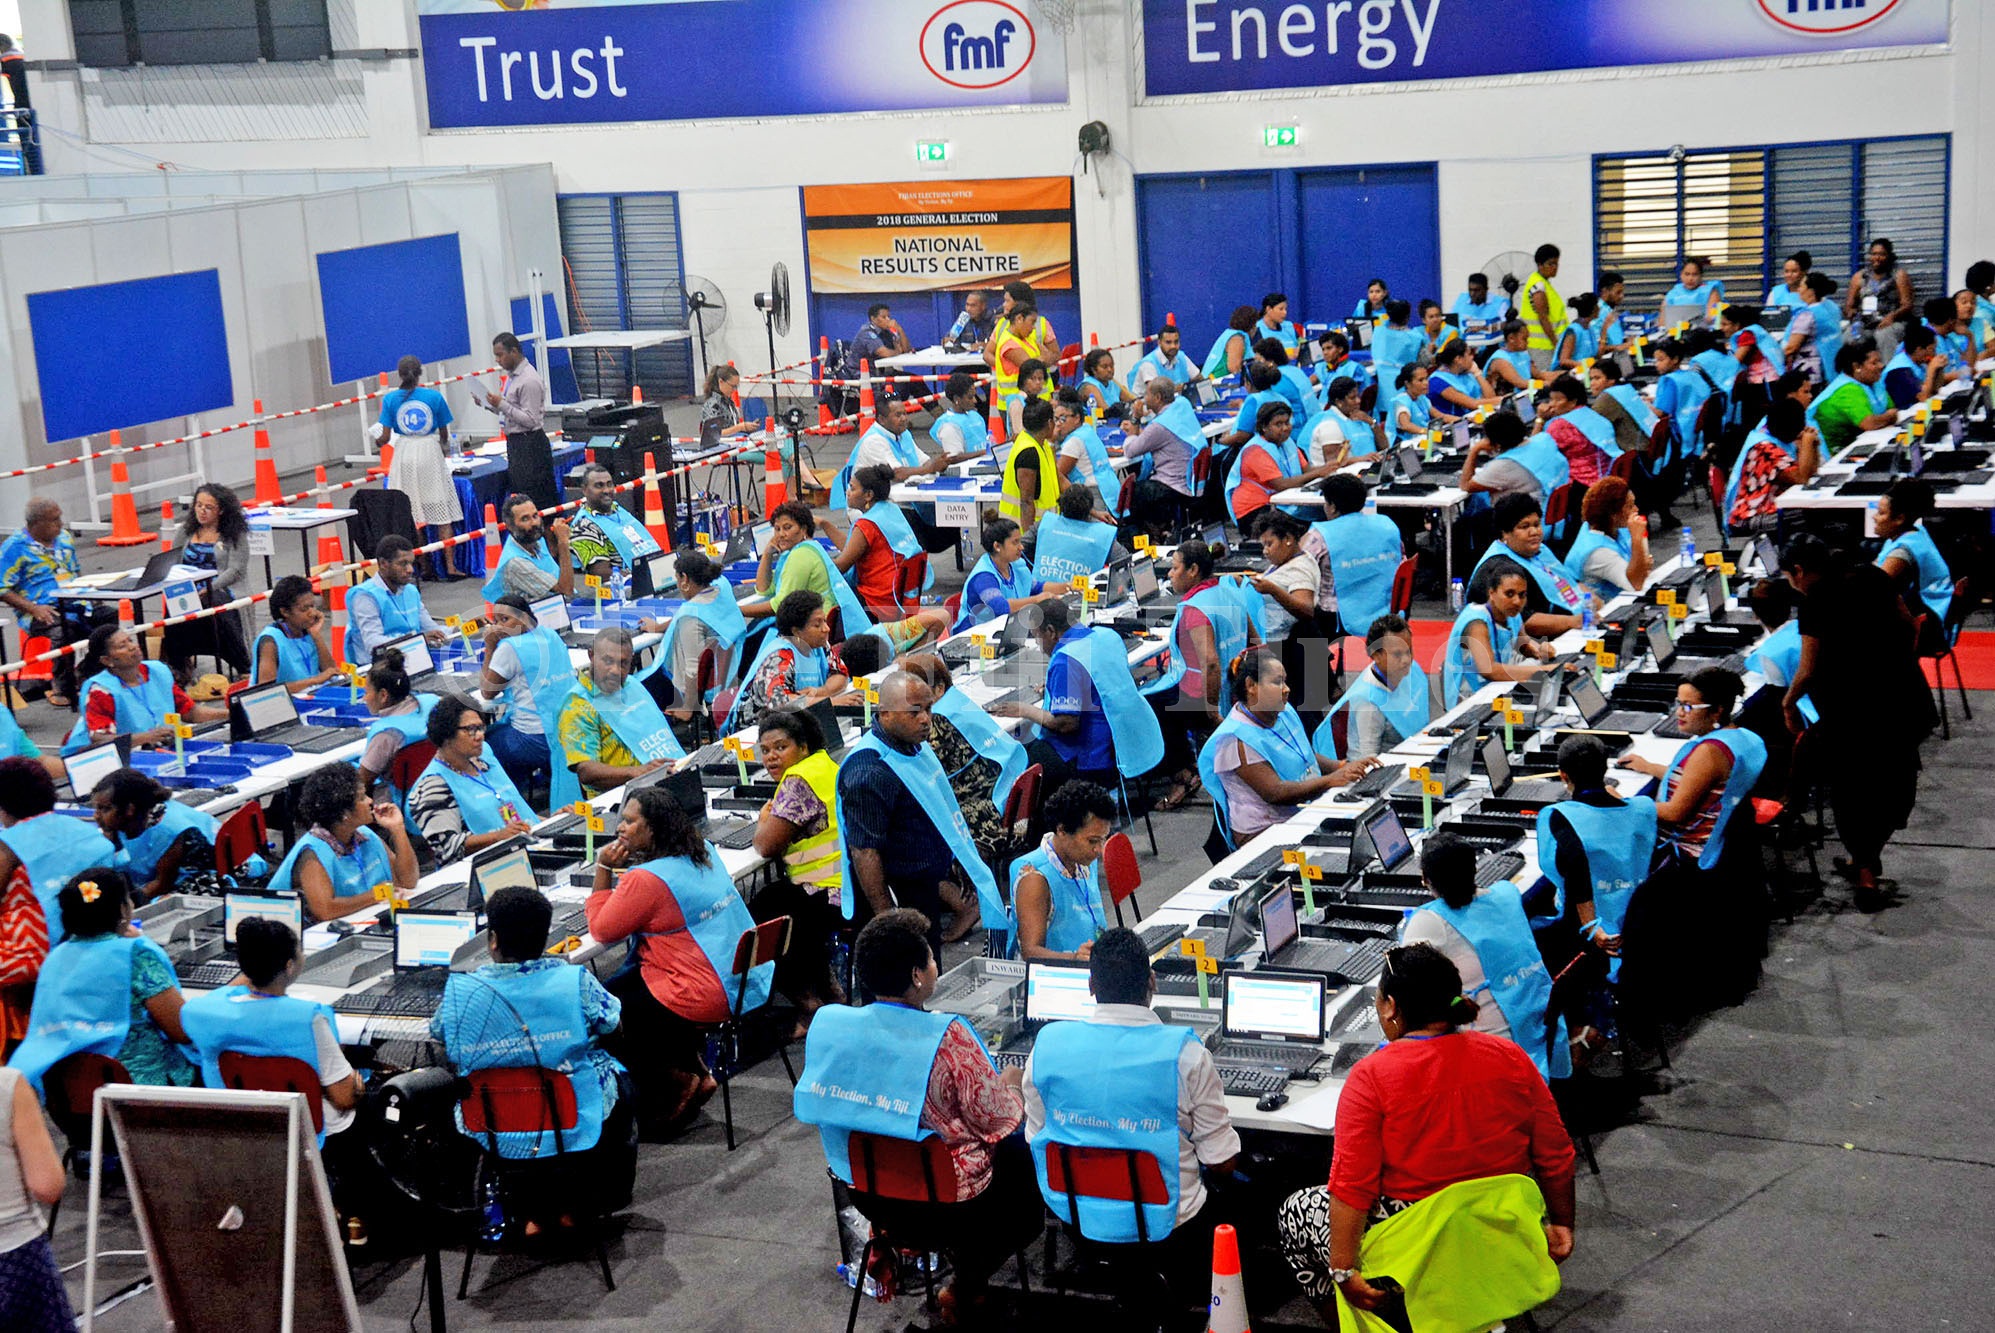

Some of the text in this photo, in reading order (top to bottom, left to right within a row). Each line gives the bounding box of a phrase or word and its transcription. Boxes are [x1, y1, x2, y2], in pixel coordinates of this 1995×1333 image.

[1186, 0, 1440, 69] Energy
[943, 19, 1016, 71] fmf
[459, 35, 628, 103] Trust
[918, 191, 951, 199] ELECTIONS
[952, 190, 973, 198] OFFICE
[877, 212, 998, 226] 2018 GENERAL ELECTION
[894, 236, 984, 253] NATIONAL
[861, 255, 1019, 275] RESULTS CENTRE
[946, 505, 967, 513] DATA
[944, 513, 969, 522] ENTRY
[1040, 555, 1092, 575] ELECTION
[1076, 578, 1085, 587] 11
[599, 589, 609, 597] 12
[1086, 591, 1096, 600] 12
[464, 624, 476, 633] 10
[983, 647, 993, 656] 10
[728, 739, 735, 749] 5
[742, 750, 749, 759] 6
[1416, 769, 1423, 779] 5
[1429, 782, 1436, 793] 6
[581, 804, 586, 814] 3
[592, 820, 599, 829] 4
[1290, 853, 1298, 863] 3
[1307, 867, 1315, 877] 4
[380, 888, 386, 898] 1
[1189, 943, 1196, 954] 1
[1203, 959, 1210, 971] 2
[540, 1029, 572, 1042] OFFICE
[809, 1081, 910, 1115] My Election, My Fiji
[1053, 1108, 1161, 1134] My Election, My Fiji
